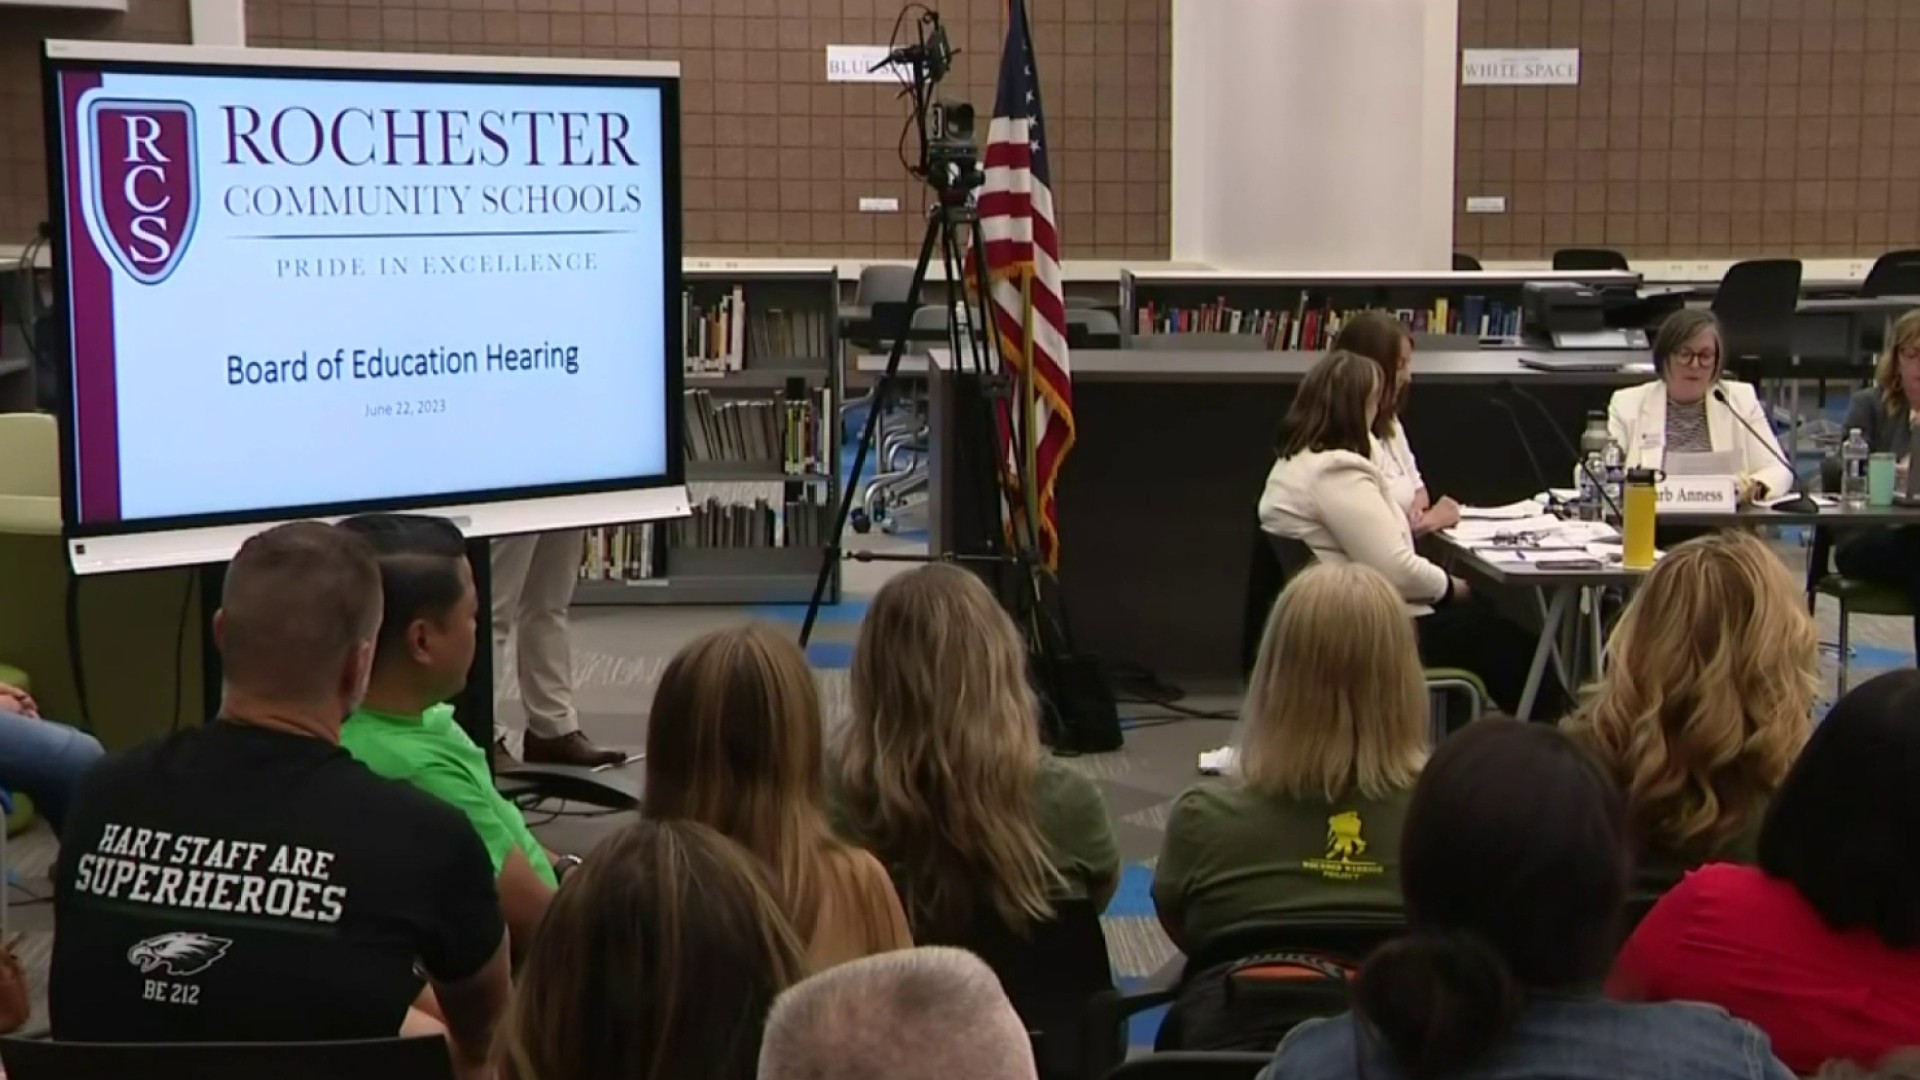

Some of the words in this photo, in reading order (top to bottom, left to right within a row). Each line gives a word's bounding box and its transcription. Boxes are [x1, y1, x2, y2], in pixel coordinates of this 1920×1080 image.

[1465, 63, 1515, 78] WHITE
[1525, 63, 1574, 78] SPACE
[220, 104, 640, 168] ROCHESTER
[223, 183, 471, 217] COMMUNITY
[481, 182, 643, 214] SCHOOLS
[276, 257, 367, 279] PRIDE
[379, 256, 410, 275] IN
[422, 252, 599, 274] EXCELLENCE
[226, 351, 308, 385] Board
[316, 348, 345, 381] of
[352, 346, 478, 380] Education
[486, 341, 580, 375] Hearing
[364, 402, 393, 418] June
[395, 401, 415, 417] 22,
[417, 399, 447, 415] 2023
[1677, 487, 1723, 502] Anness
[98, 823, 172, 861] HART
[170, 835, 267, 872] STAFF
[268, 844, 335, 881] ARE
[75, 853, 346, 923] SUPERHEROES
[143, 979, 169, 1001] BE
[170, 983, 200, 1005] 212
